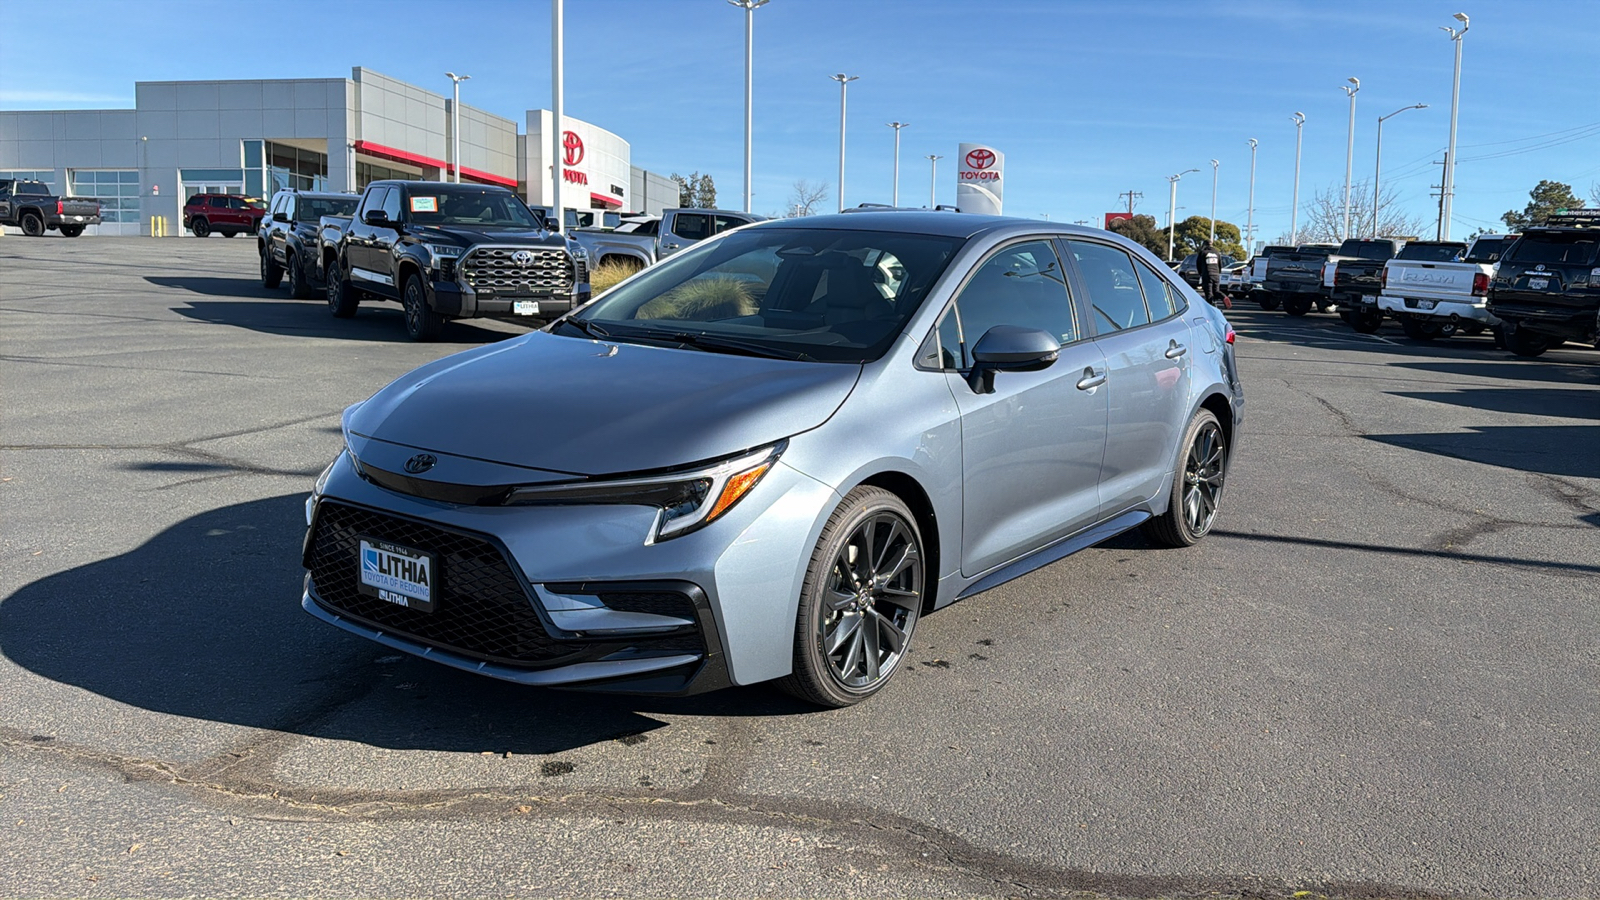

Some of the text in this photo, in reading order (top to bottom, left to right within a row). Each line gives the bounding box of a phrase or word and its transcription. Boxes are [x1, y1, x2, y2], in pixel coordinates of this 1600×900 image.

[960, 172, 1000, 180] TOYOTA
[1402, 272, 1455, 284] RAM
[380, 542, 408, 555] SINCE 1946
[378, 552, 428, 586] LITHIA
[364, 571, 429, 596] TOYOTA OF REDDING
[386, 591, 408, 607] LITHIA
